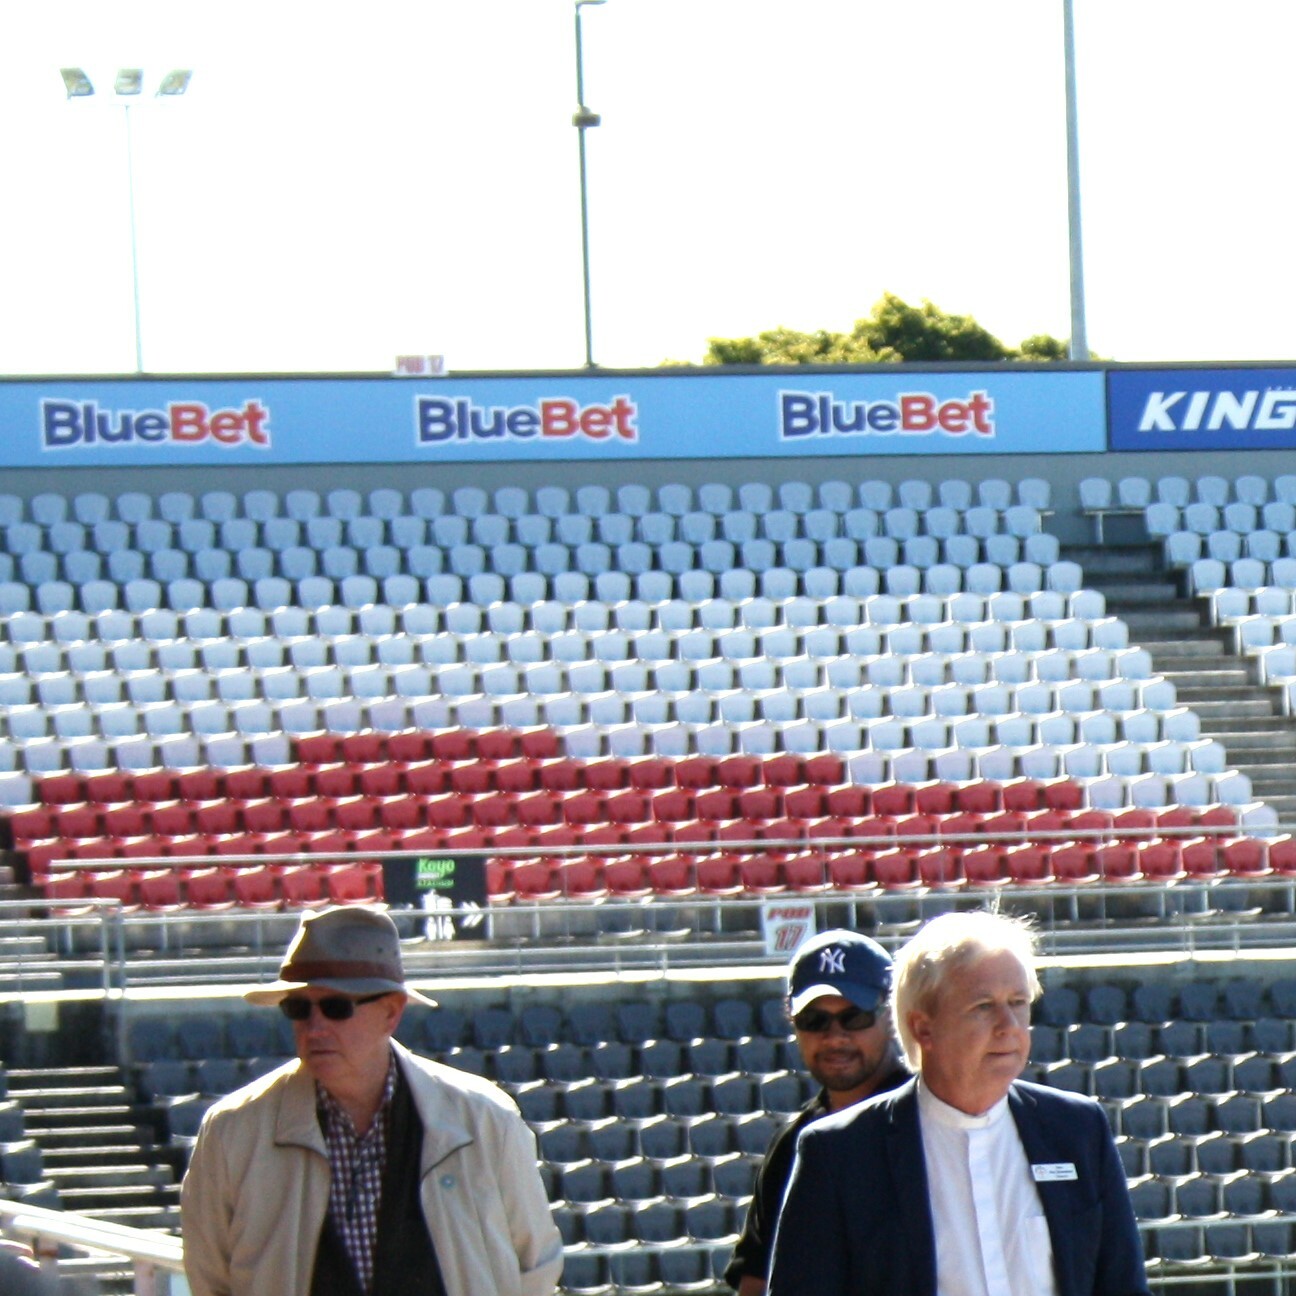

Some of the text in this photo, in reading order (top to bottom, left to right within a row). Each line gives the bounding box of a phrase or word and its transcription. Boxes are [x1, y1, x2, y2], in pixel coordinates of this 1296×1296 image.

[42, 400, 270, 447] BlueBet
[417, 397, 637, 443] BlueBet
[781, 392, 993, 437] BlueBet
[767, 907, 811, 921] POD
[774, 922, 806, 951] 17
[818, 947, 847, 974] NY
